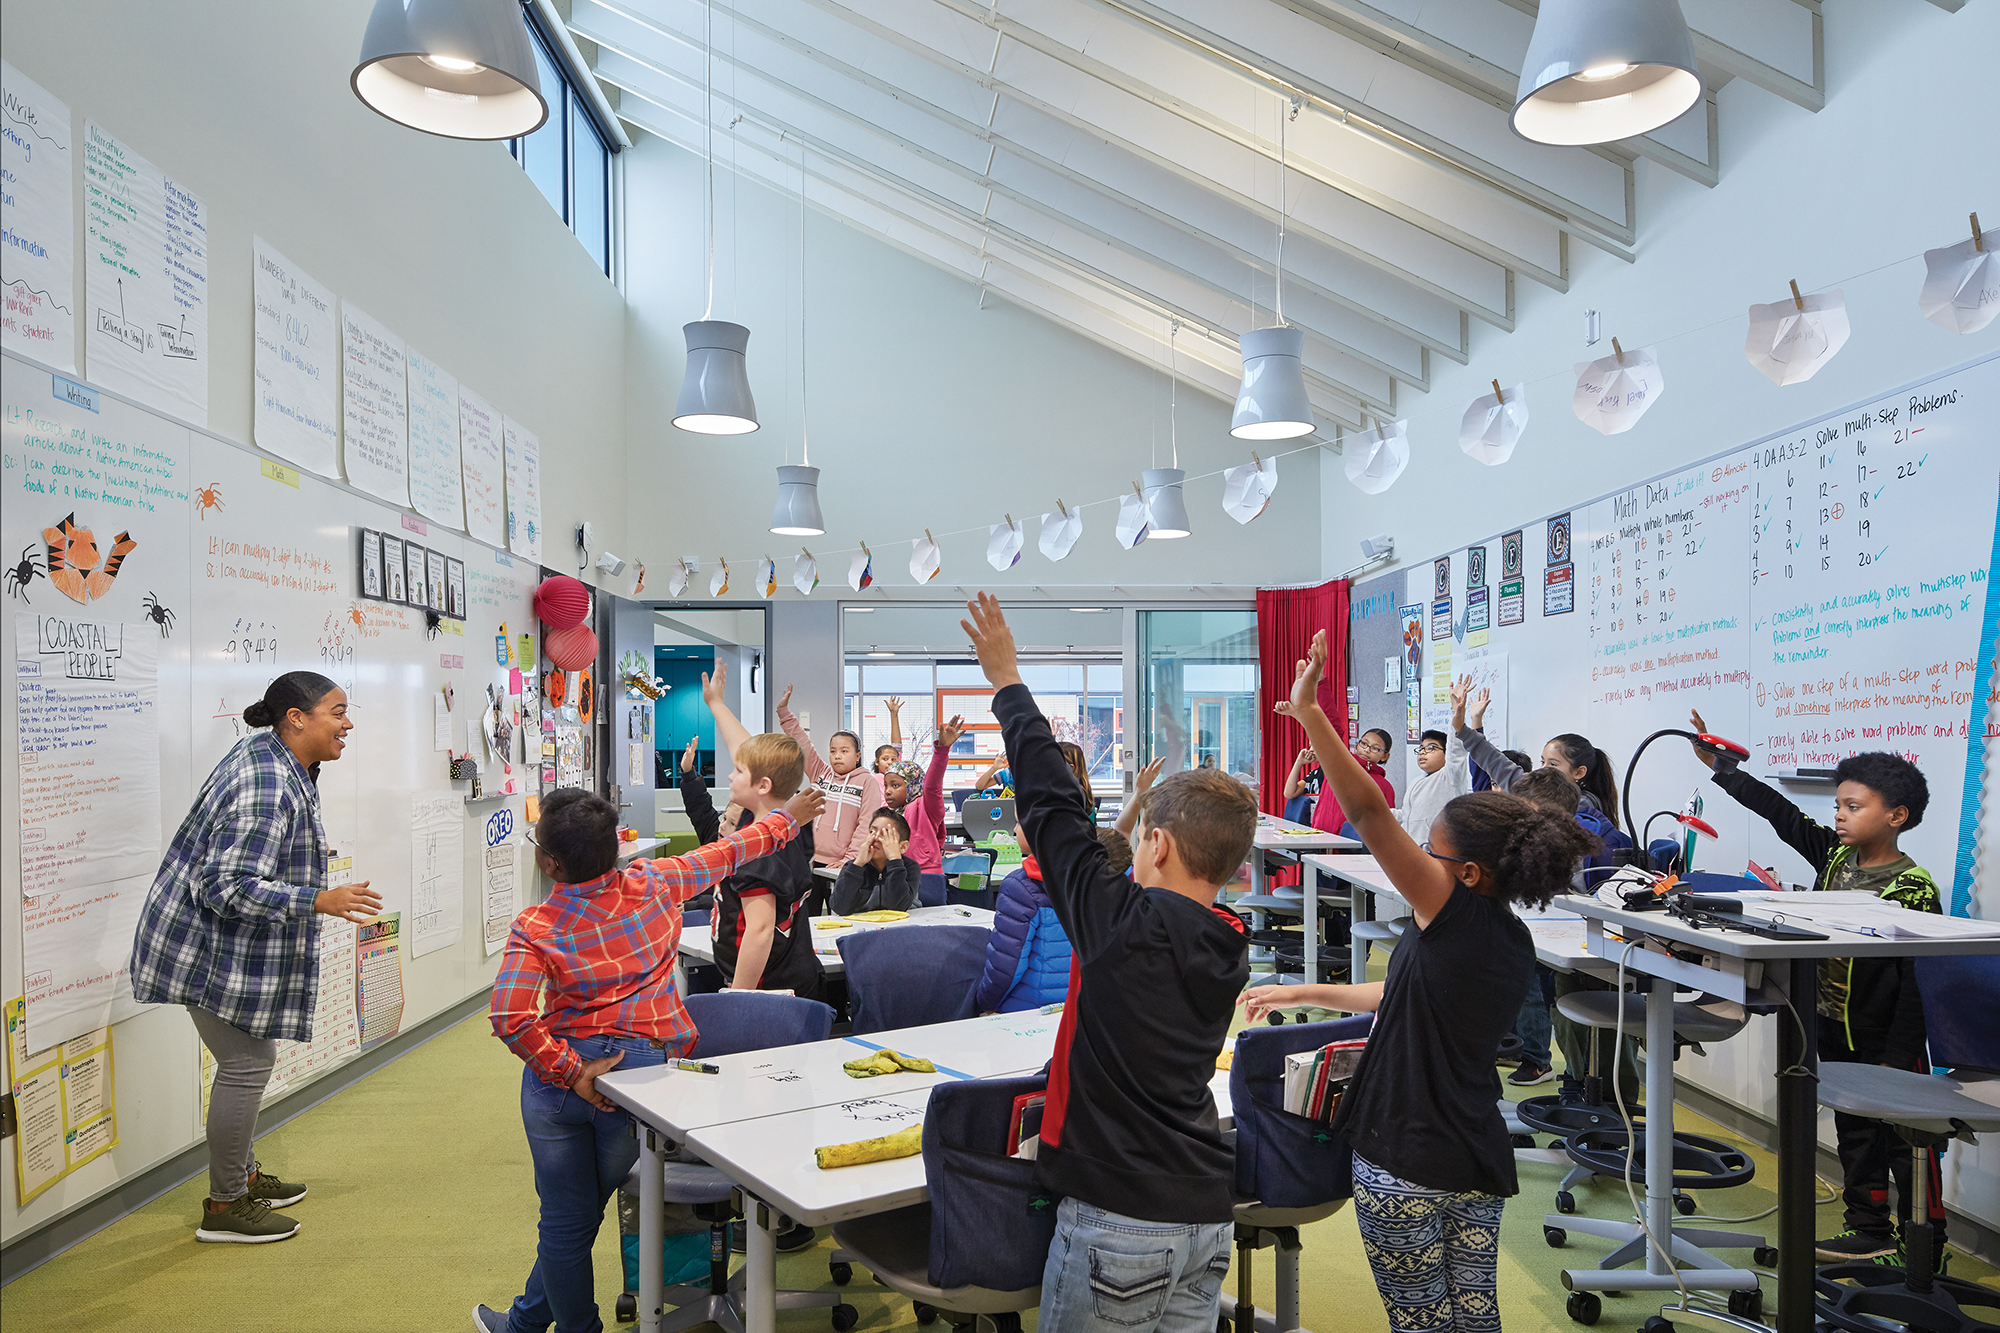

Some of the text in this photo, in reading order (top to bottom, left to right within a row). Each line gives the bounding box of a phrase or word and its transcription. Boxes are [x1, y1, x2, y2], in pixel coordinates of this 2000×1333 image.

[3, 87, 37, 125] Write
[66, 384, 91, 410] Writing
[71, 428, 86, 442] and
[116, 443, 127, 453] an
[1816, 428, 1839, 449] Solve
[1894, 428, 1908, 444] 21
[24, 434, 56, 452] article
[59, 441, 84, 457] about
[87, 448, 91, 459] a
[96, 451, 117, 467] Native
[119, 457, 154, 475] American
[1857, 440, 1867, 456] 16
[30, 460, 45, 470] can
[88, 468, 101, 480] the
[1820, 454, 1825, 469] 11
[1897, 461, 1917, 479] 22
[1787, 469, 1794, 487] 6
[1857, 464, 1867, 483] 17
[23, 473, 45, 493] foods
[49, 479, 57, 495] of
[64, 485, 69, 496] a
[1819, 482, 1829, 499] 12
[1613, 482, 1669, 523] Math Data
[1786, 496, 1792, 510] 7
[1859, 491, 1870, 509] 18
[1754, 504, 1760, 519] 2
[1819, 508, 1830, 525] 13
[1753, 525, 1760, 543] 3
[1786, 519, 1792, 534] 8
[1858, 519, 1870, 538] 19
[225, 542, 240, 556] can
[1786, 538, 1793, 555] 9
[1819, 534, 1829, 551] 14
[1752, 550, 1759, 567] 4
[1821, 556, 1831, 571] 15
[1858, 552, 1872, 567] 20
[224, 566, 237, 578] can
[1752, 570, 1759, 586] 5
[1784, 565, 1793, 579] 10
[1820, 595, 1838, 613] and
[1886, 584, 1910, 601] solves
[1970, 568, 1988, 582] wor
[1804, 622, 1820, 639] and
[1824, 620, 1853, 638] correctly
[1893, 606, 1908, 623] the
[1912, 603, 1952, 620] meaning
[1960, 594, 1971, 612] of
[45, 616, 118, 652] COASTAL
[68, 650, 113, 678] PEOPLE
[1772, 651, 1786, 666] the
[1714, 671, 1721, 684] to
[1802, 683, 1814, 696] one
[1840, 671, 1850, 691] of
[1853, 676, 1859, 690] a
[1926, 661, 1948, 676] word
[1931, 678, 1942, 693] of
[1775, 702, 1791, 718] and
[1835, 697, 1872, 712] interprets
[1874, 693, 1890, 708] the
[1893, 691, 1931, 709] meaning
[1932, 695, 1949, 706] the
[1768, 732, 1795, 751] rarely
[1801, 729, 1819, 744] able
[1822, 728, 1831, 745] to
[1862, 724, 1882, 738] word
[1886, 721, 1928, 741] problems
[1933, 721, 1954, 738] and
[1803, 750, 1841, 767] interpret
[486, 808, 513, 847] OREO
[71, 1057, 95, 1073] Apostrophe
[22, 1078, 38, 1091] Comma
[78, 1115, 112, 1138] Quotation Marks
